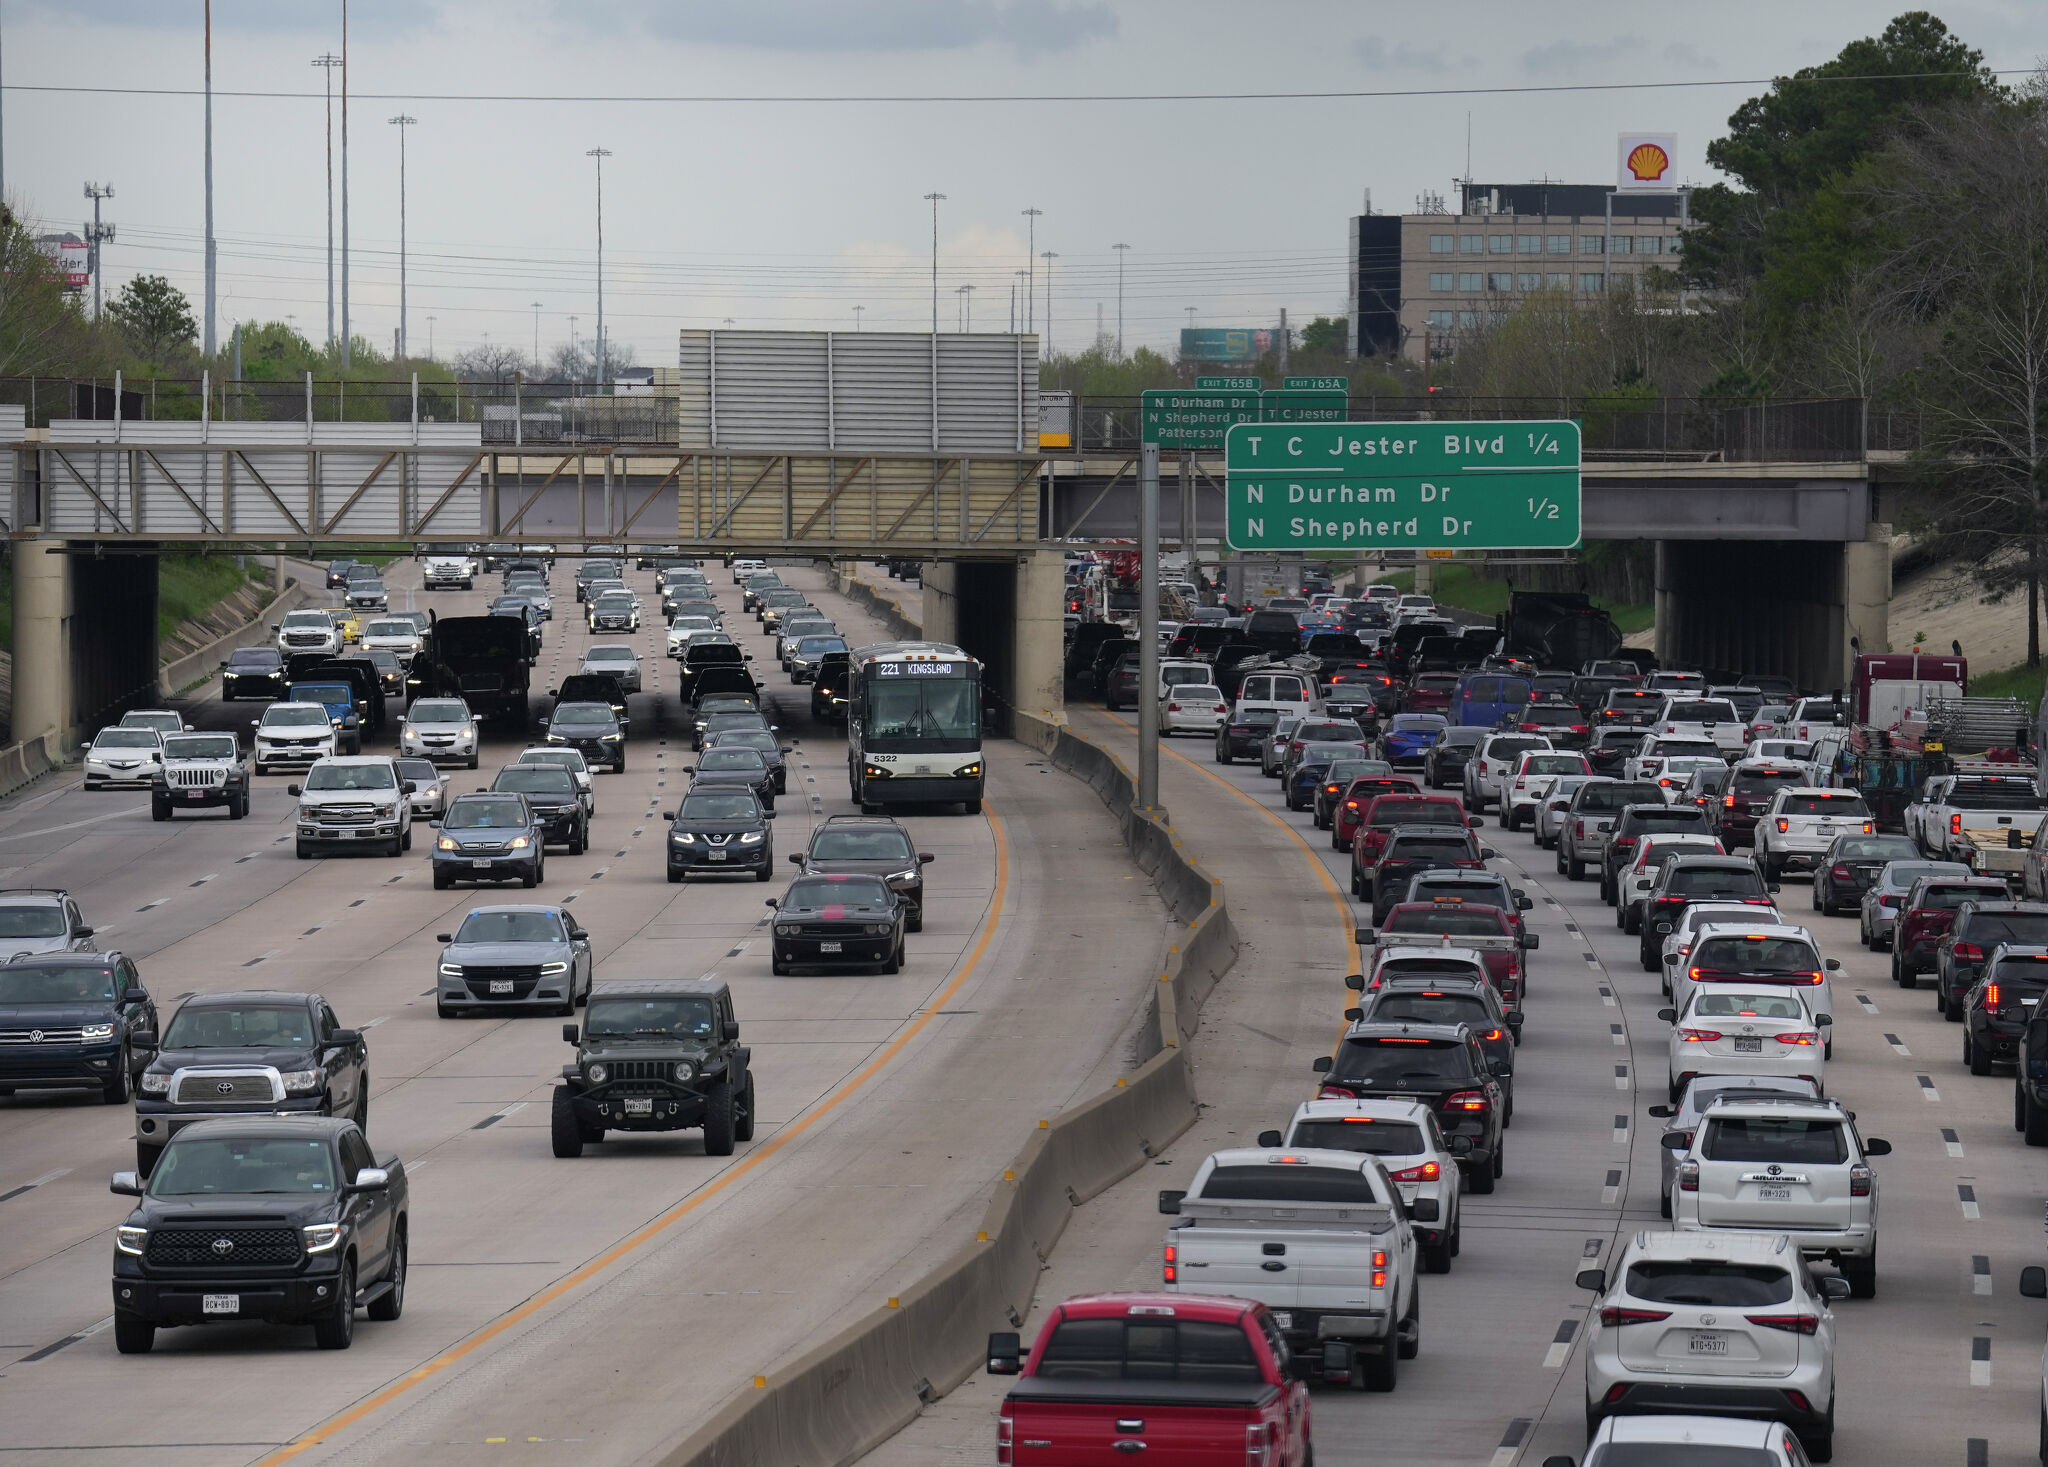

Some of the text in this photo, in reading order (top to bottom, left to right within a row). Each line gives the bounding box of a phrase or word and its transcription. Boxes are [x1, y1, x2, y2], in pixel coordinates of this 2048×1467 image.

[1223, 379, 1253, 388] 765B
[1155, 398, 1247, 408] N Durham Dr
[1149, 413, 1252, 425] N Shepherd Dr
[1269, 409, 1340, 419] T C Jester
[1158, 427, 1224, 438] Patterson
[1248, 433, 1559, 456] T C Jester Blvd 1/4
[1248, 484, 1450, 503] N Durham Dr
[1527, 498, 1559, 519] 1/2
[1248, 517, 1472, 540] N Shepherd Dr
[880, 663, 952, 676] 221 KINGSLAND
[874, 755, 898, 763] 5322
